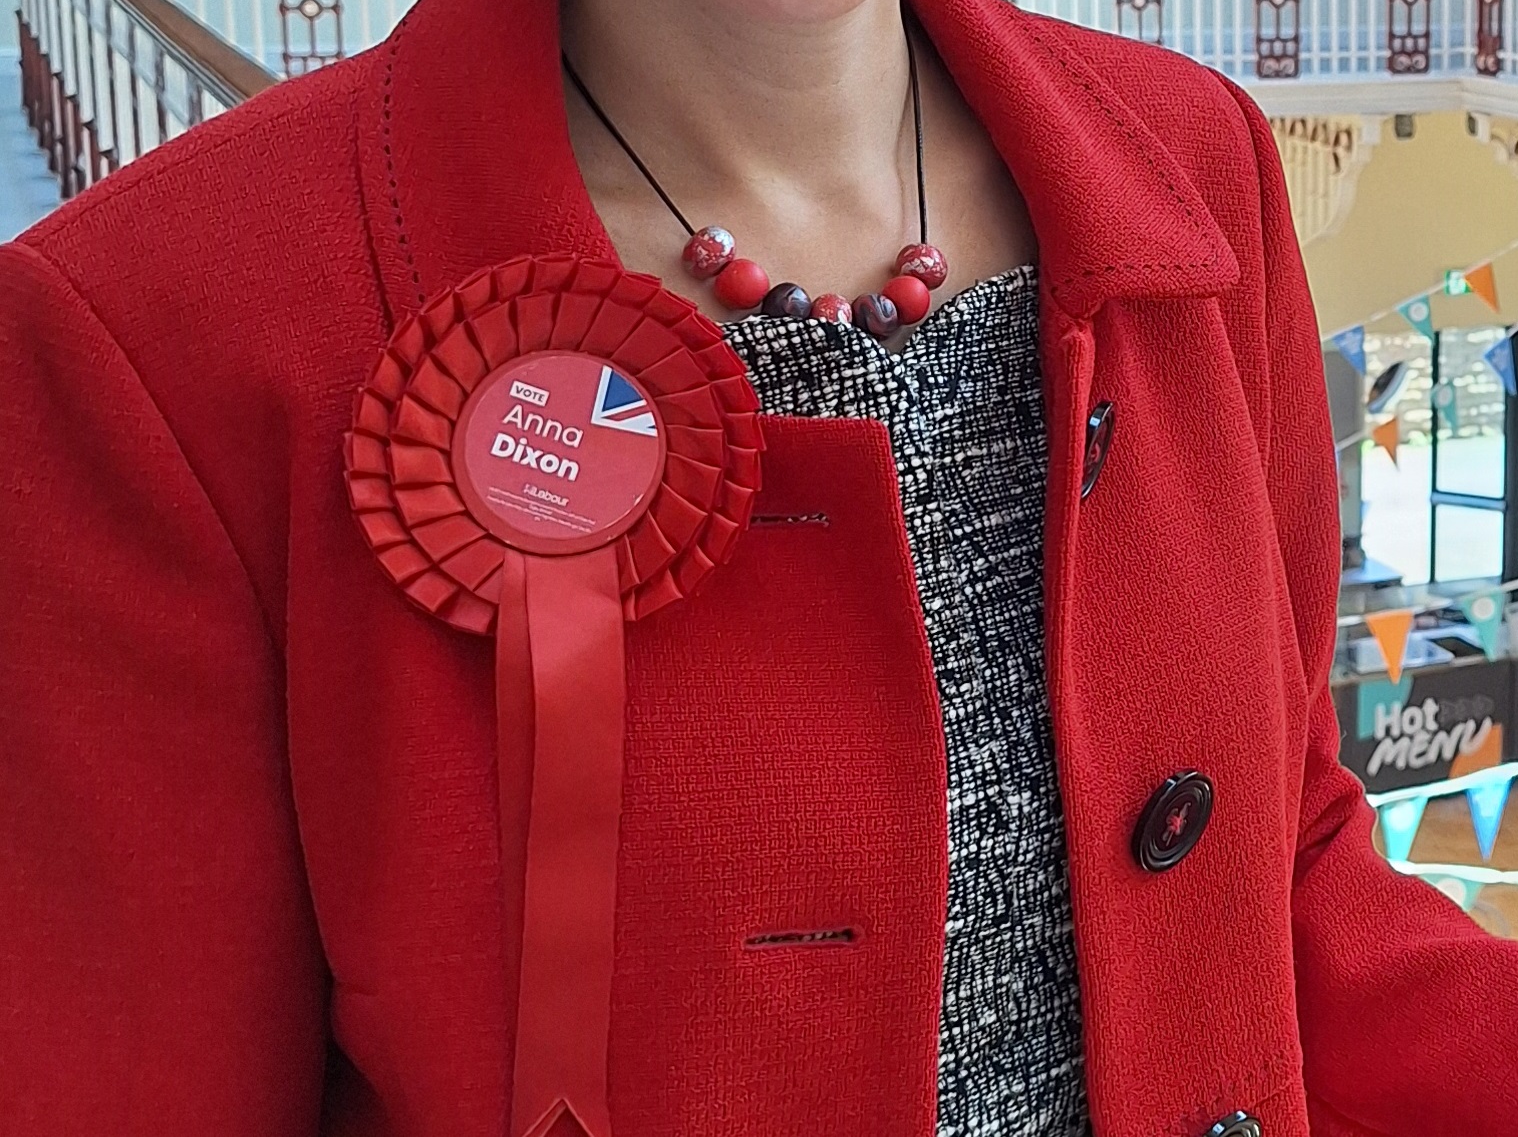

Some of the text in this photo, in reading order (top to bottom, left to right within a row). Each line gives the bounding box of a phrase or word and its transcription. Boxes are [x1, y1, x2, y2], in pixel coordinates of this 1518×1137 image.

[514, 385, 546, 403] VOTE
[502, 404, 584, 448] Anna
[490, 432, 580, 481] Dixon
[531, 485, 569, 507] Labour
[1374, 697, 1440, 740] Hot
[1366, 716, 1493, 777] MENU
